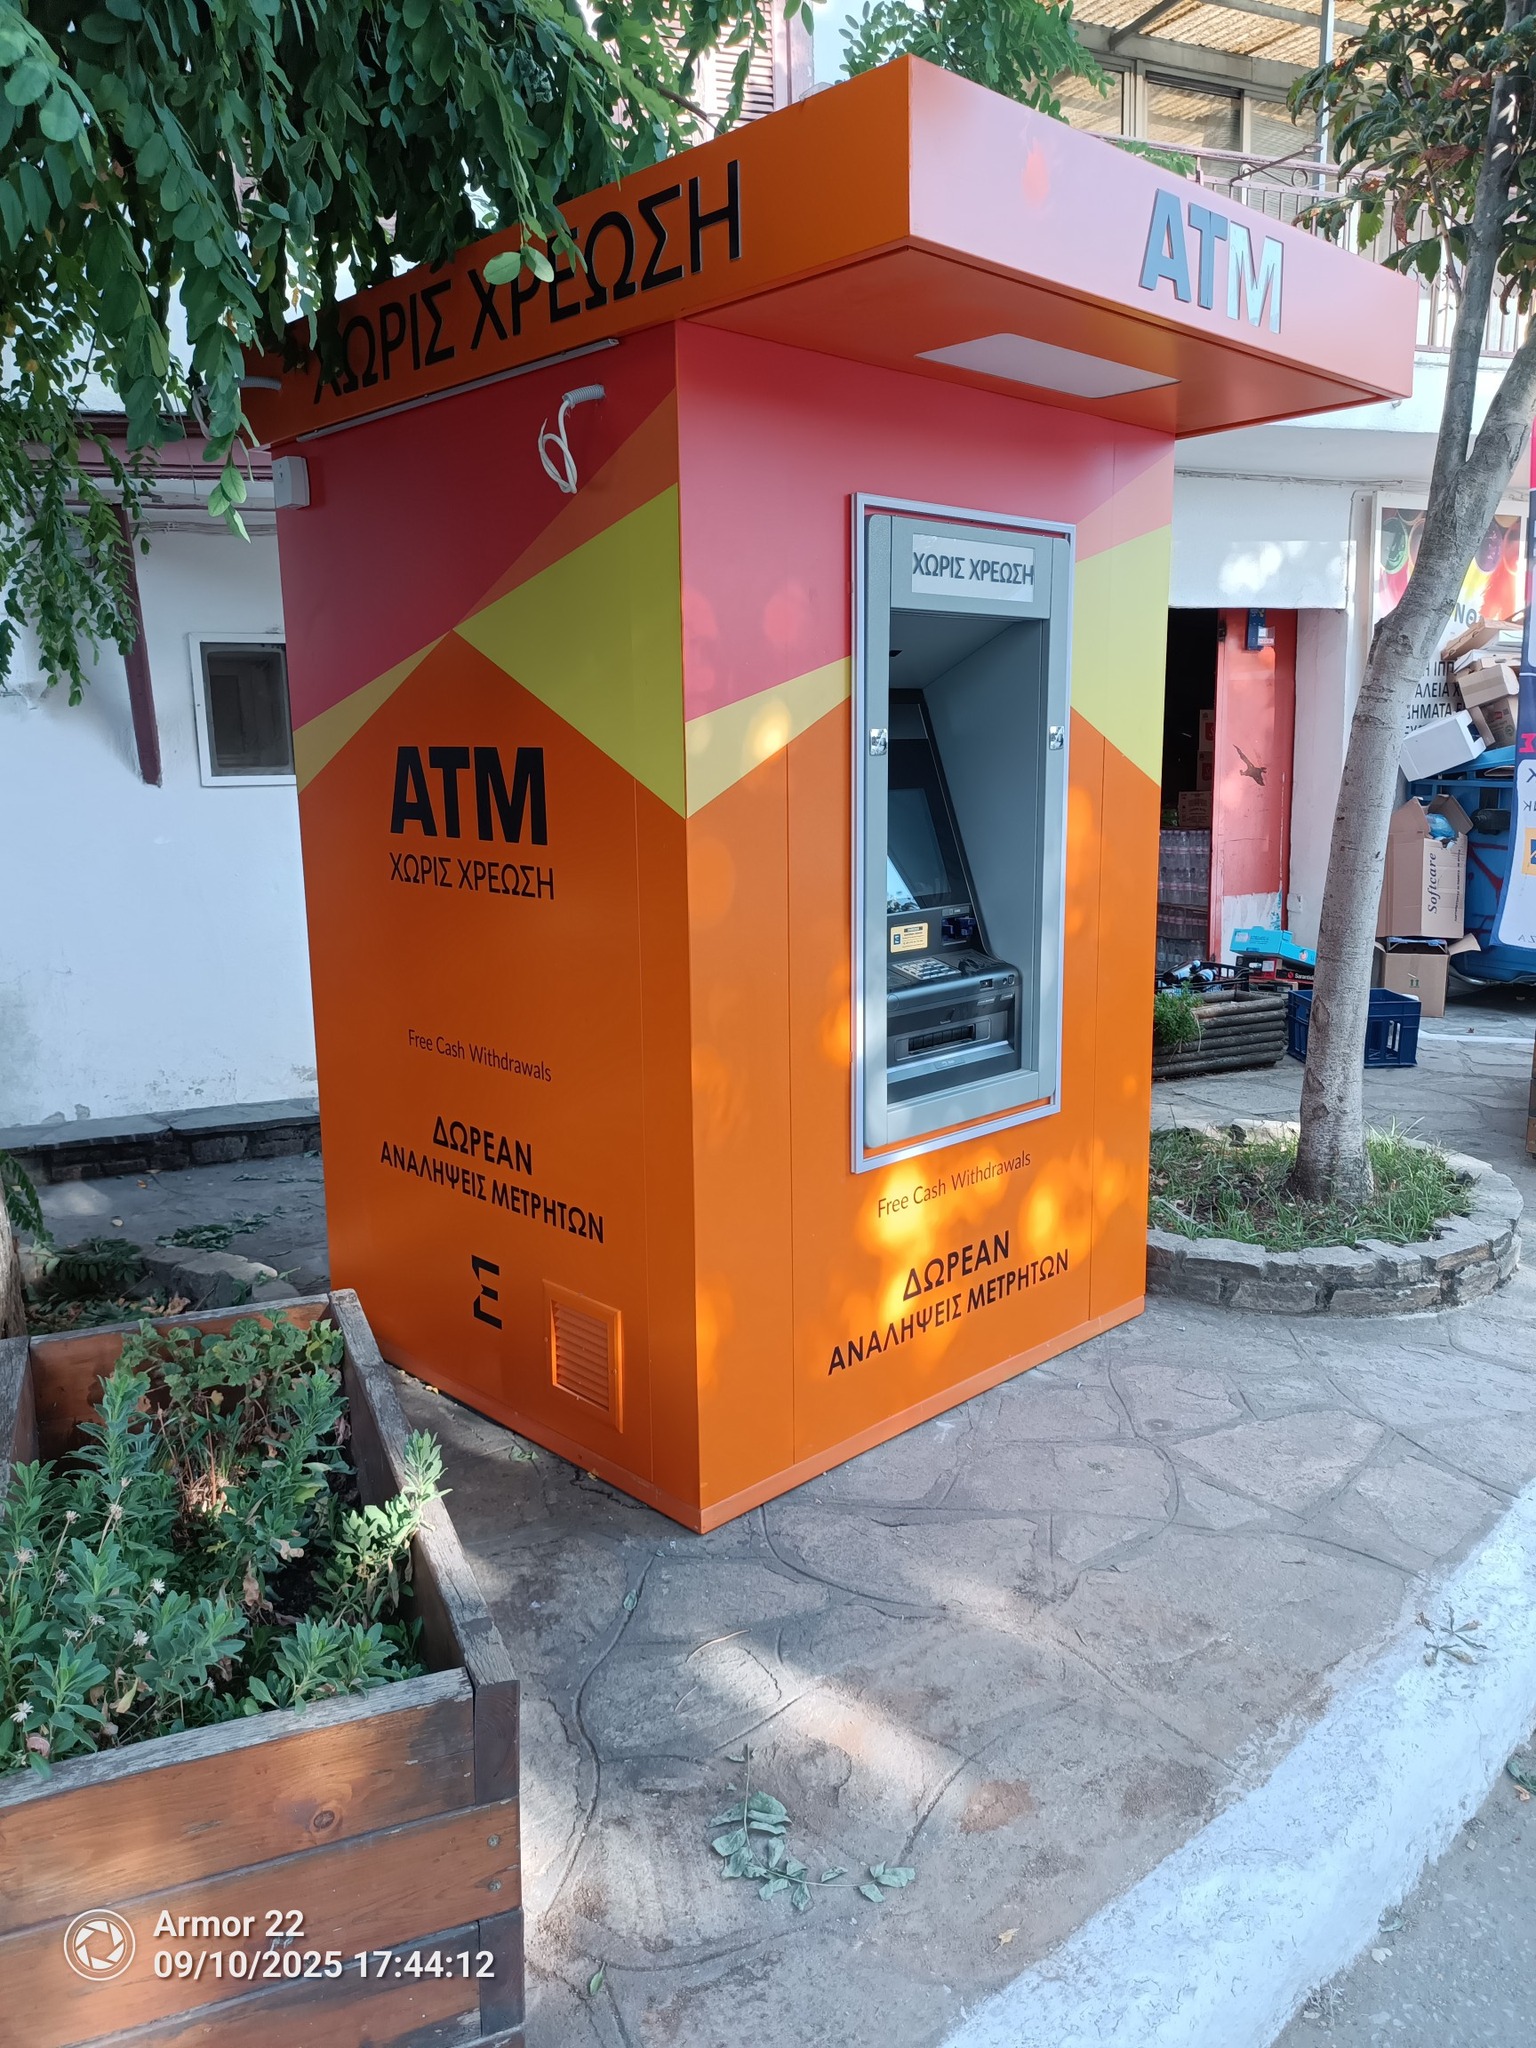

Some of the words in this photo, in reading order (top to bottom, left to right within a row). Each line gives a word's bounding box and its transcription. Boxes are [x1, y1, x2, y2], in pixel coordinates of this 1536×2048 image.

[1138, 188, 1284, 334] ATM
[912, 551, 965, 580] ΧΩΡΙΣ
[969, 558, 1034, 586] ΧΡΕΩΣΗ
[1407, 702, 1452, 720] ΗΜΑΤΑ
[1415, 682, 1450, 698] ΑΛΕΙΑ
[390, 746, 548, 846] ATM
[389, 852, 453, 888] ΧΩΡΙΣ
[457, 858, 555, 901] ΧΡΕΩΣΗ
[1427, 852, 1441, 914] Softcare
[408, 1028, 433, 1052] Free
[436, 1036, 465, 1060] Cash
[469, 1043, 552, 1083] Withdrawals
[432, 1115, 533, 1176] ΔΩΡΕΑΝ
[380, 1140, 488, 1201] ΑΝΑΛΗΨΕΙΣ
[491, 1179, 604, 1244] ΜΕΤΡΗΤΩΝ
[877, 1195, 909, 1219] Free
[913, 1179, 947, 1205] Cash
[951, 1150, 1031, 1191] Withdrawals
[903, 1230, 1010, 1302] ΔΩΡΕΑΝ
[828, 1293, 962, 1376] ΑΝΑΛΗΨΕΙΣ
[967, 1248, 1069, 1314] ΜΕΤΡΗΤΩΝ
